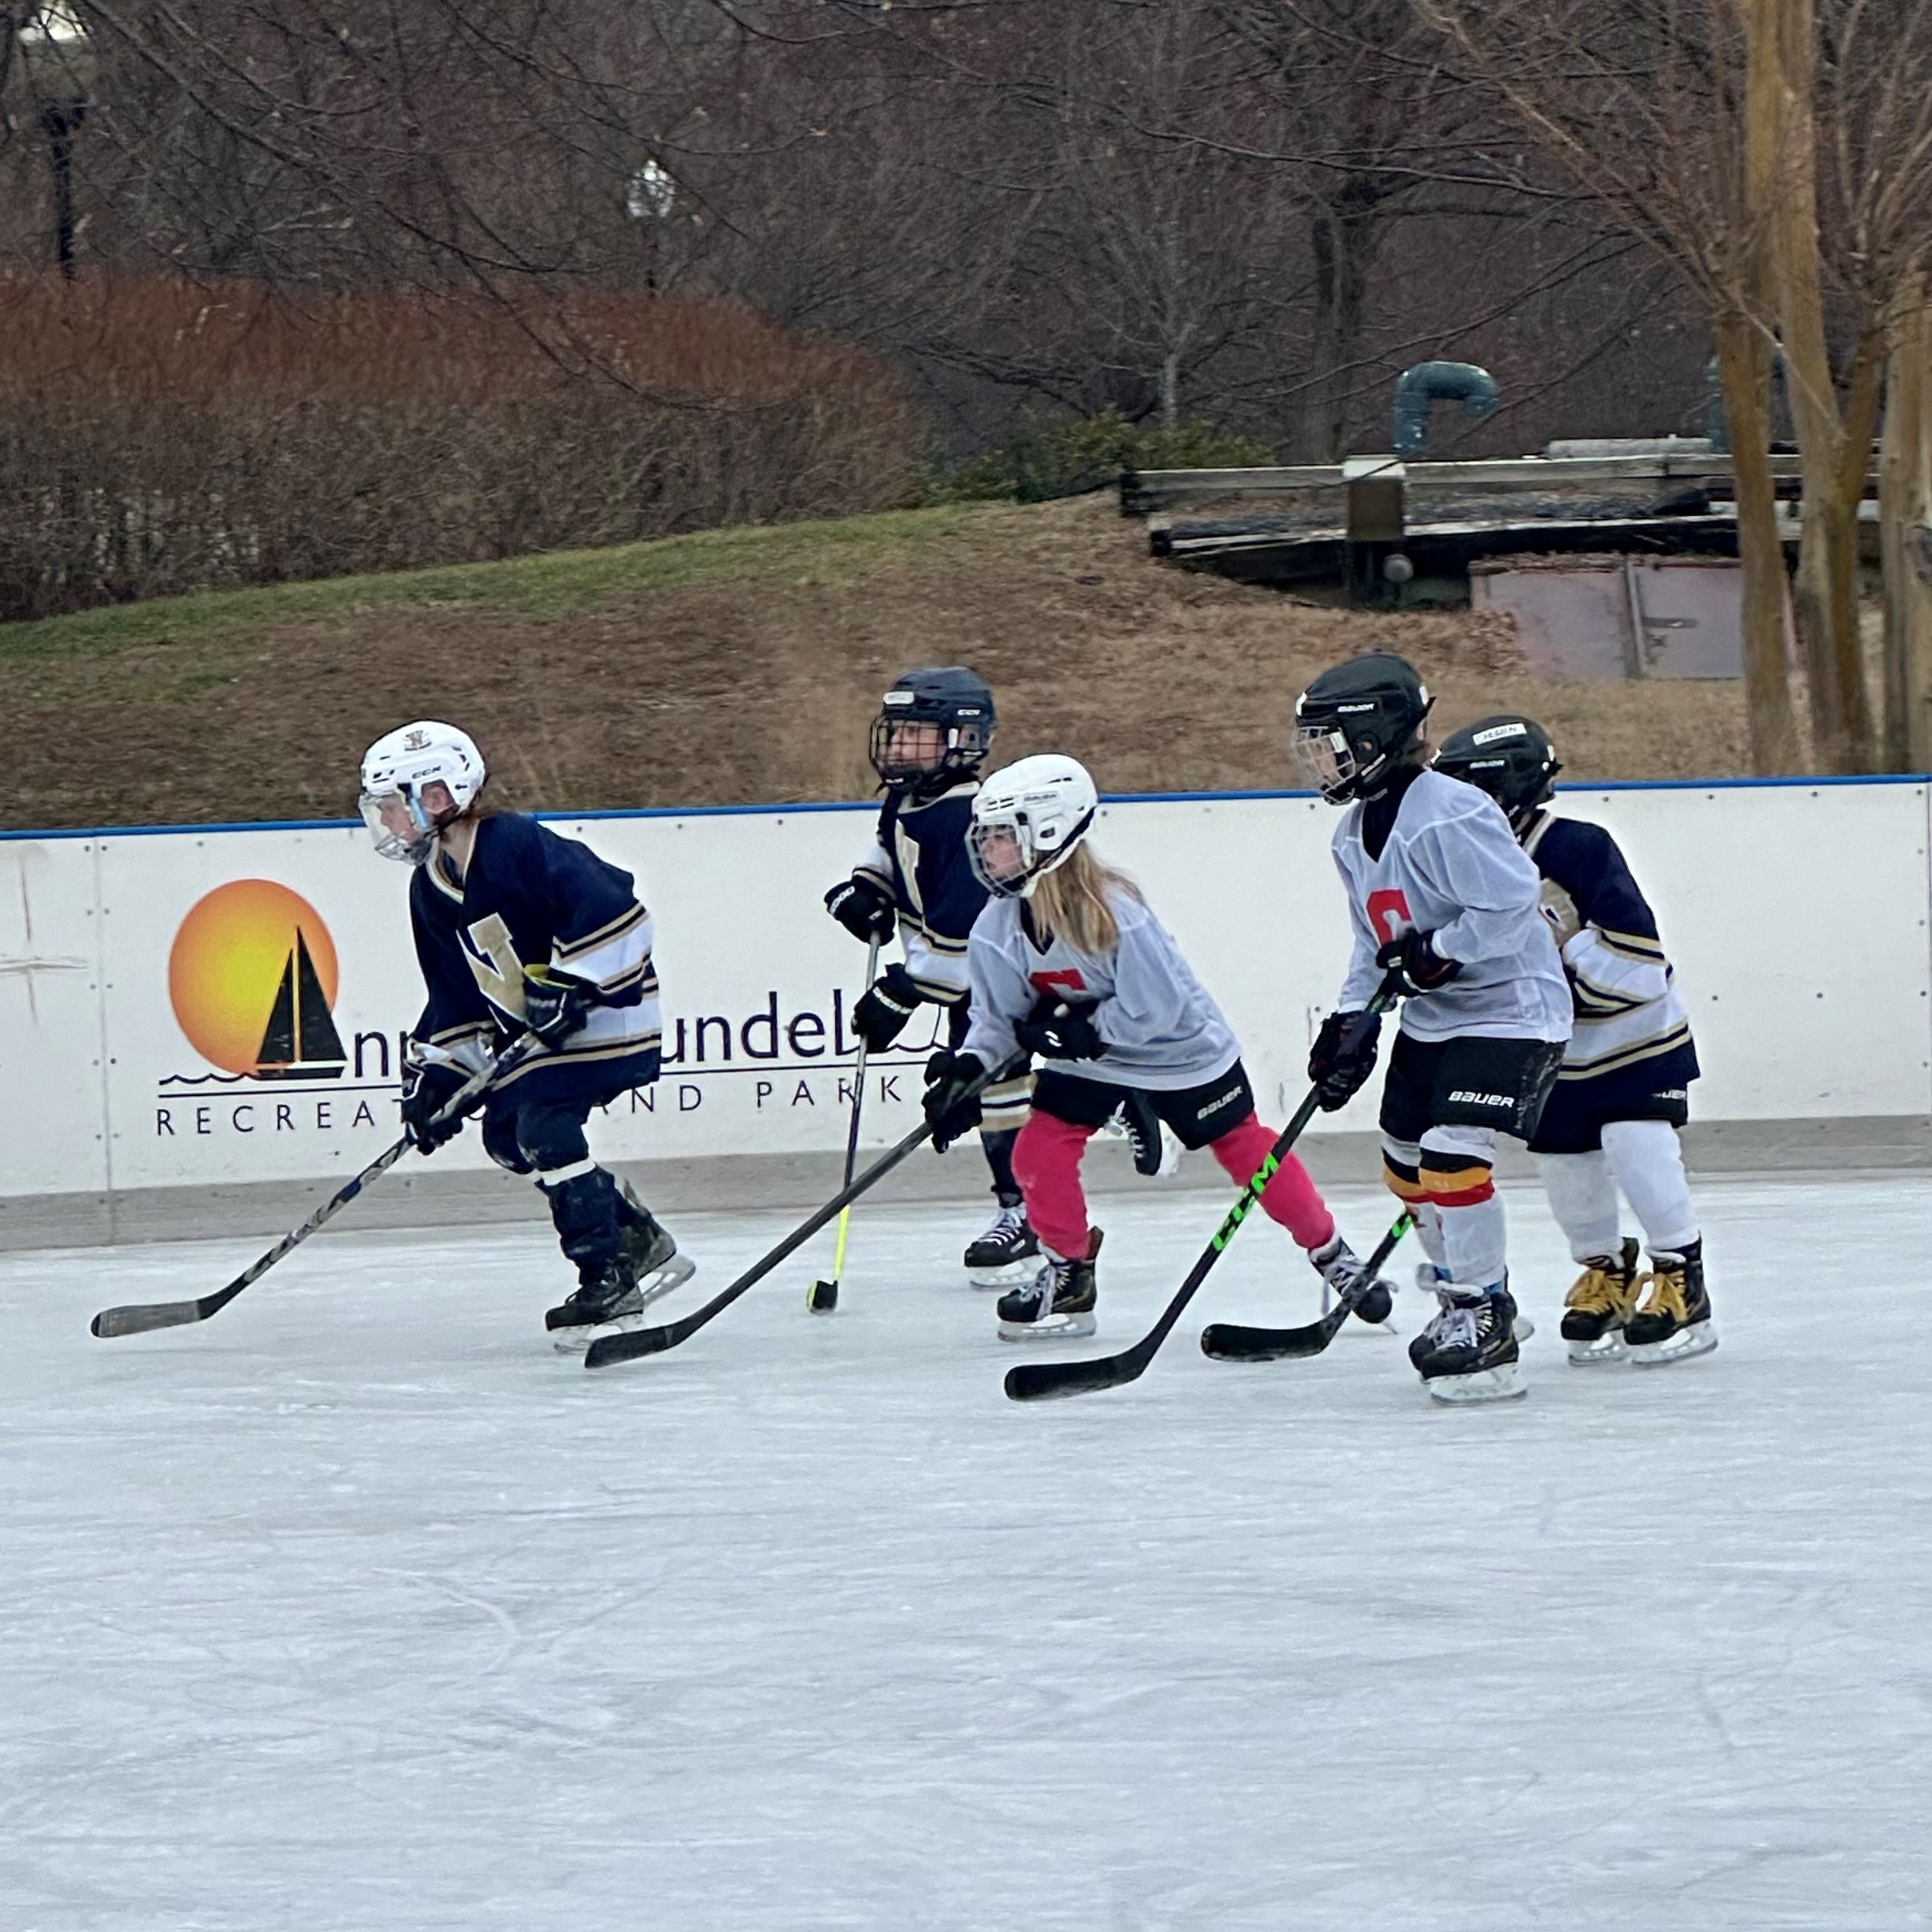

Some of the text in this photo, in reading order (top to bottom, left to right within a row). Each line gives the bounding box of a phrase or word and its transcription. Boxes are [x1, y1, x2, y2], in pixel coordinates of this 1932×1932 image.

[660, 988, 856, 1064] undel
[599, 1085, 701, 1113] ND
[1448, 1090, 1514, 1108] BAUER
